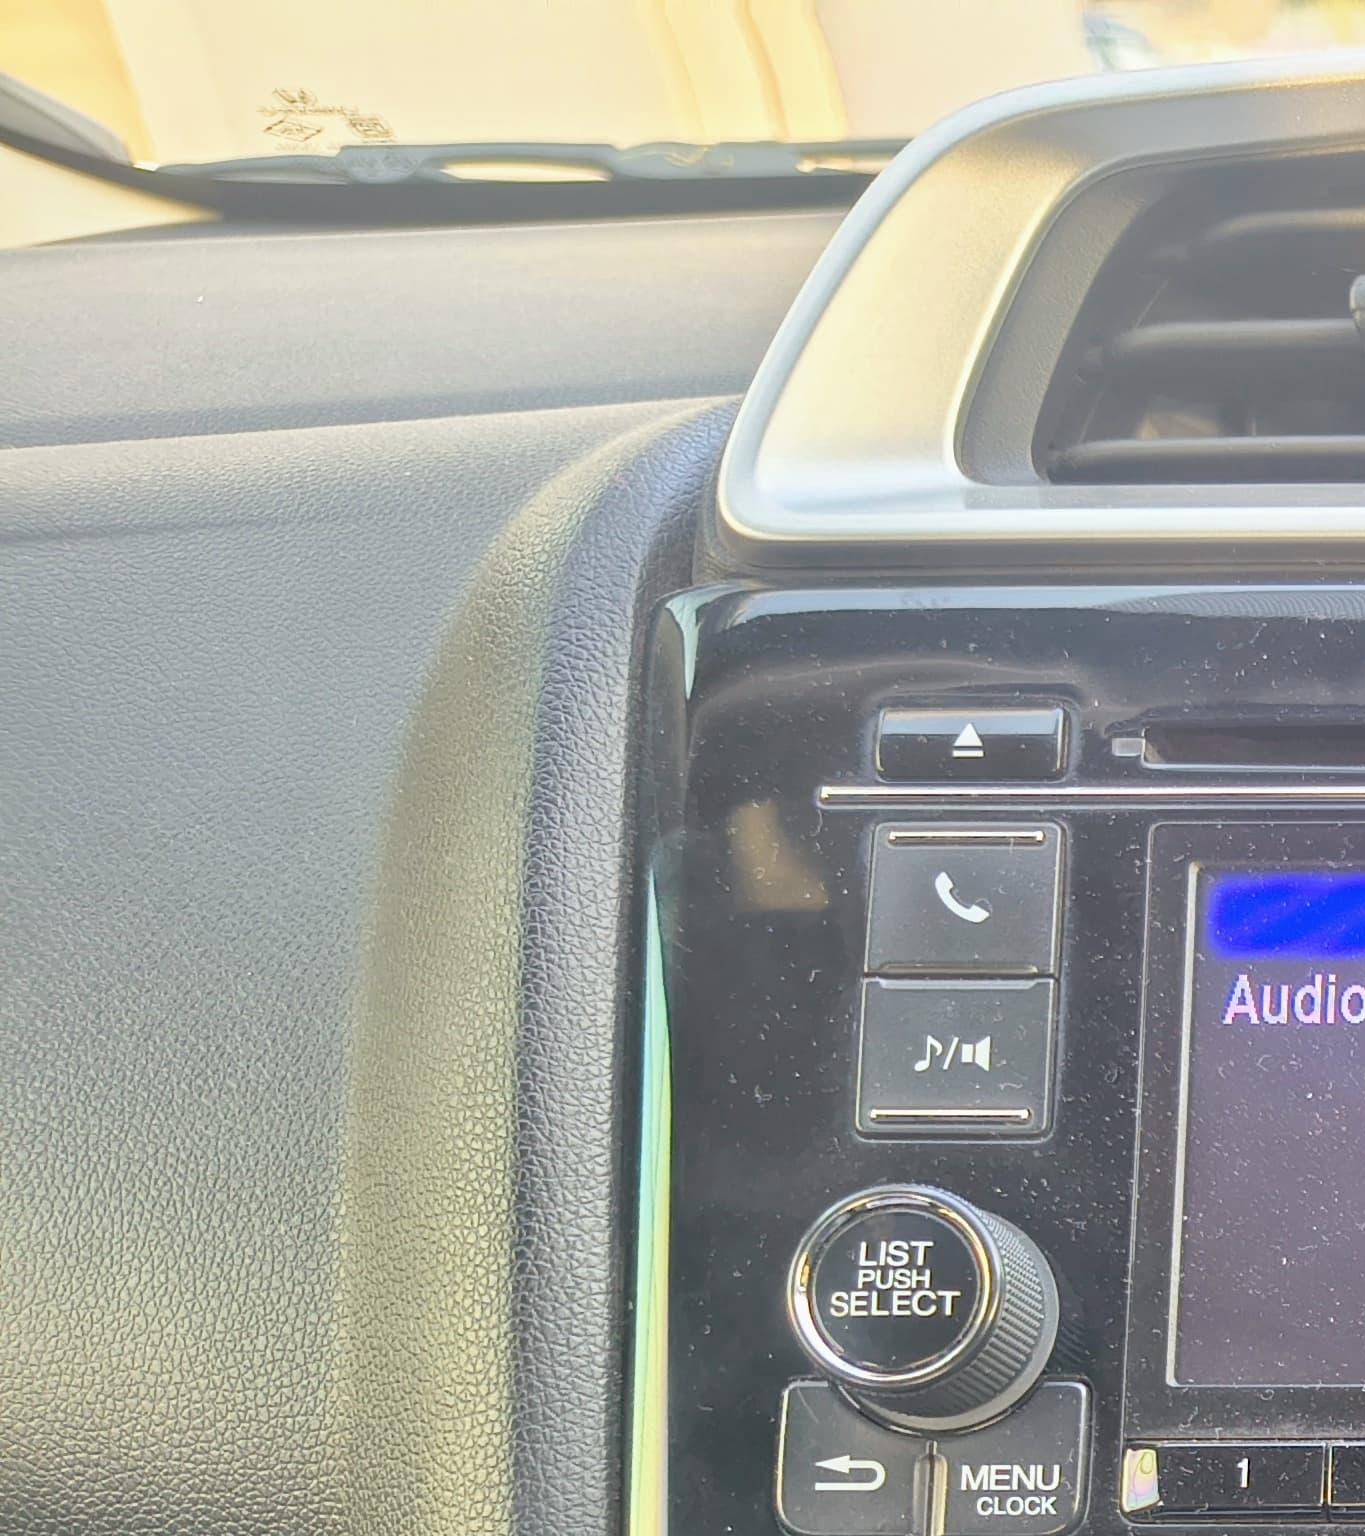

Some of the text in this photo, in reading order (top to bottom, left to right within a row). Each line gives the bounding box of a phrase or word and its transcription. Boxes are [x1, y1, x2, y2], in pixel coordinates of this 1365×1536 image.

[858, 1240, 934, 1267] LIST
[857, 1268, 931, 1290] PUSH
[829, 1289, 961, 1318] SELECT
[960, 1464, 1060, 1491] MENU
[1237, 1457, 1249, 1488] 1
[976, 1496, 1057, 1516] CLOCK
